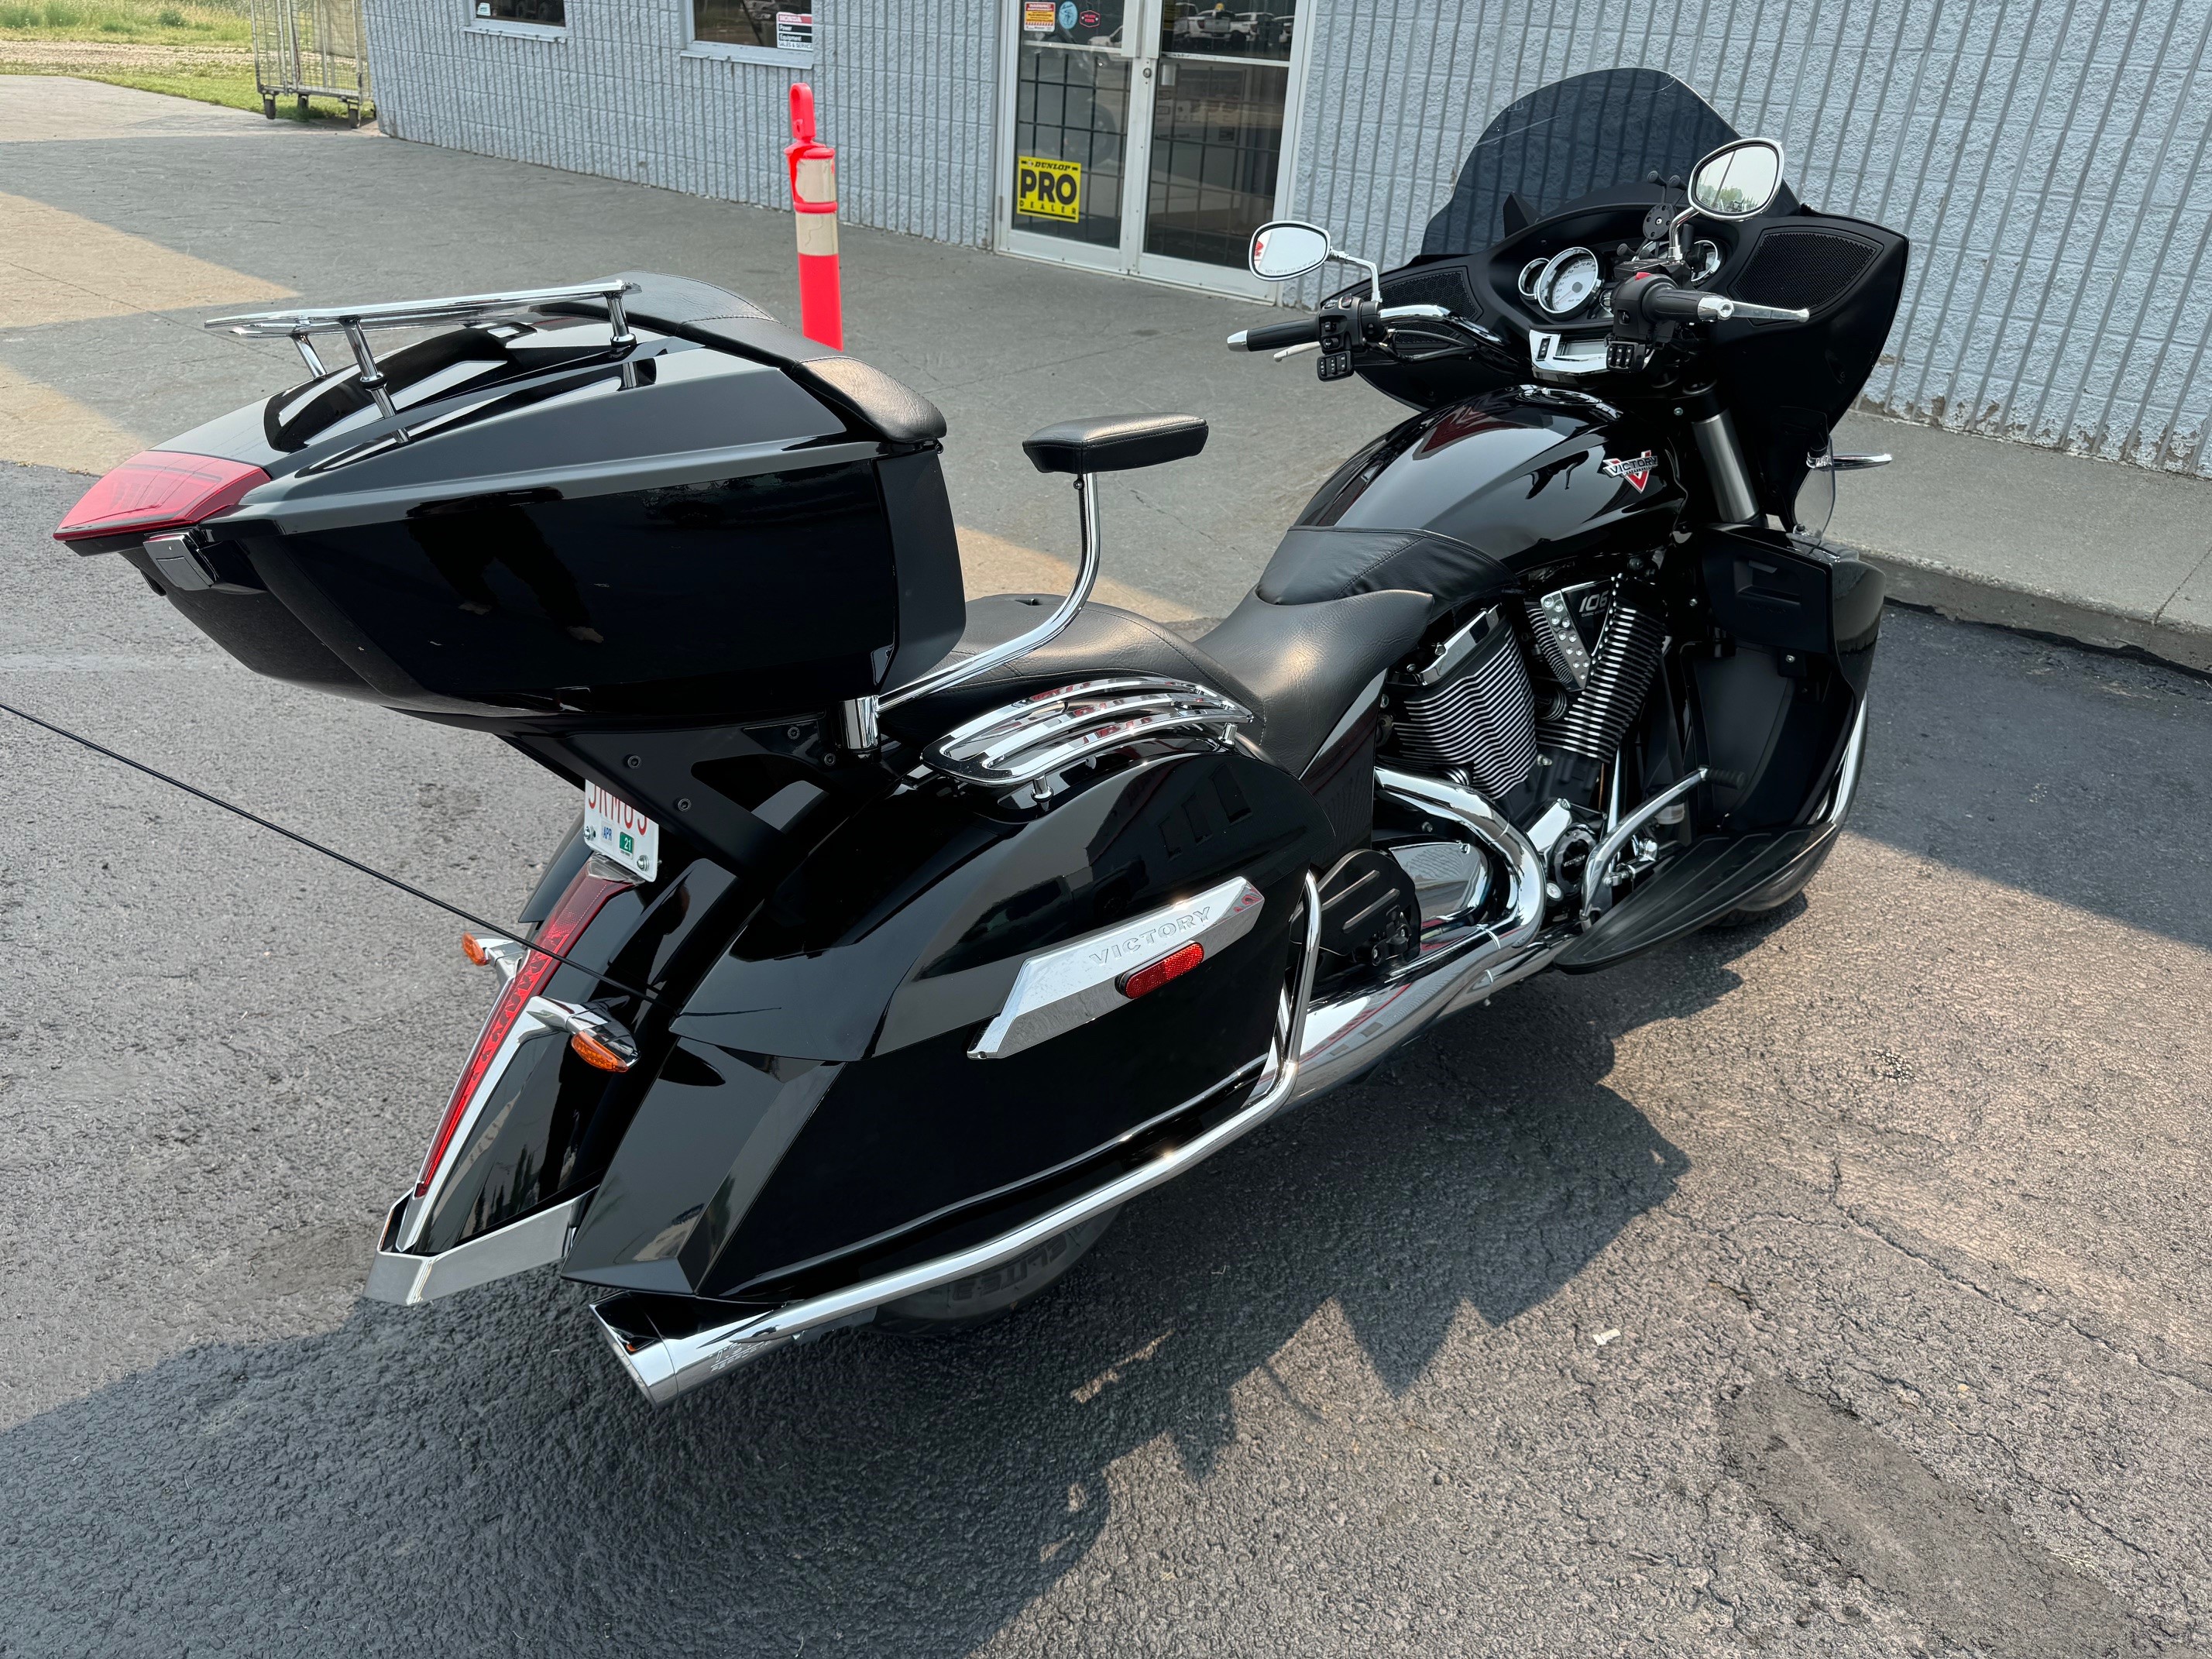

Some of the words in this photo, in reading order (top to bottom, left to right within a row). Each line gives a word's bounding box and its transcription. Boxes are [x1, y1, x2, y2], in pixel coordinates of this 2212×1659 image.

[1035, 161, 1070, 170] DUNLOP
[1020, 168, 1077, 205] PRO
[1019, 200, 1077, 215] DEALER
[1610, 456, 1657, 473] VICTORY
[1578, 589, 1609, 613] 106
[603, 826, 613, 842] APR
[623, 837, 631, 851] 21
[1089, 906, 1211, 966] VICTORY
[980, 1234, 1068, 1297] ELITE
